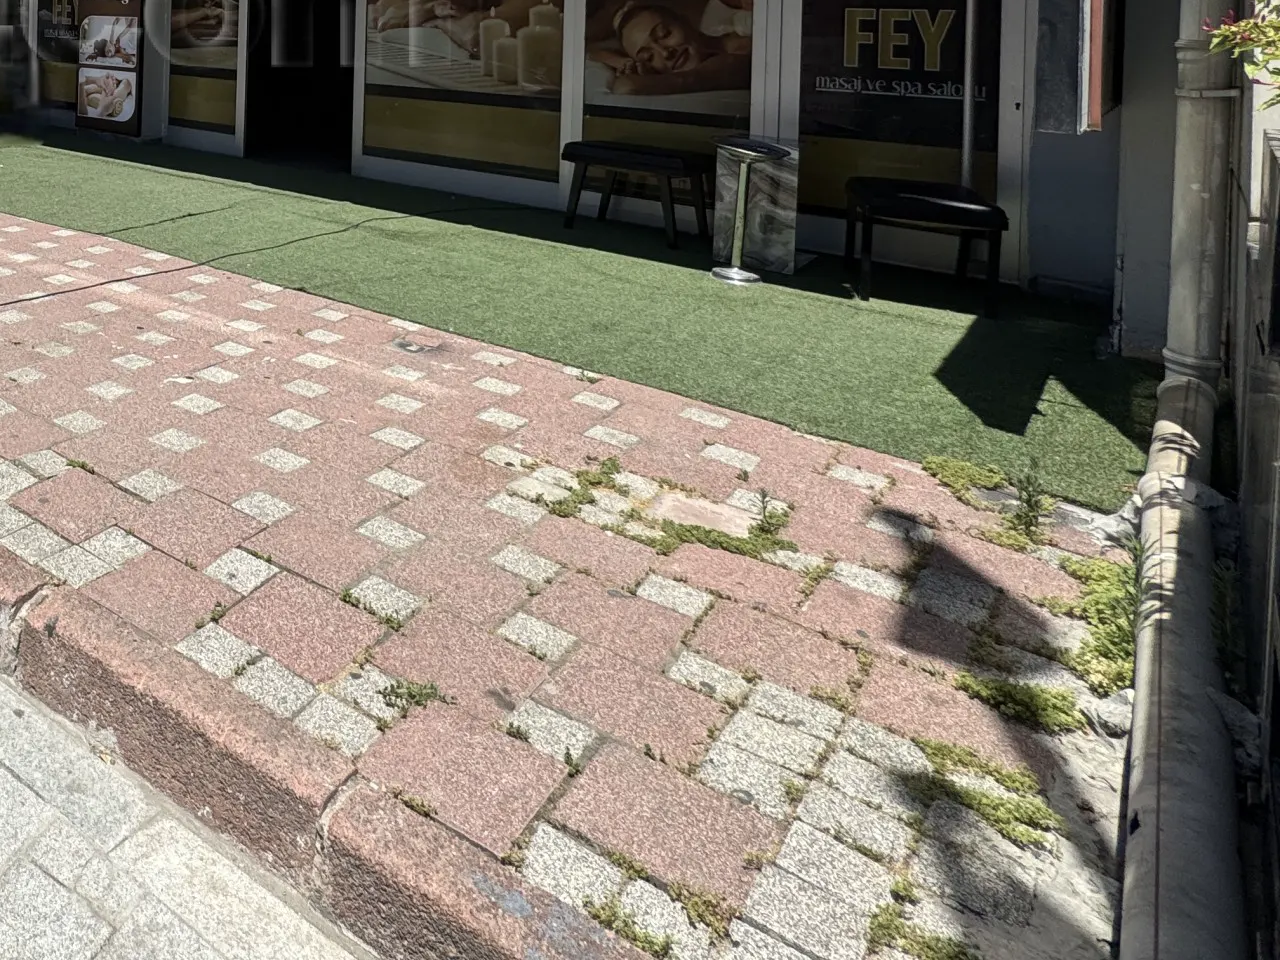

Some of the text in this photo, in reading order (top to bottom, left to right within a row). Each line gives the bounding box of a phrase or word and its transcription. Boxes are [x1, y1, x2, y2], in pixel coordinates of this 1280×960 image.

[842, 7, 956, 72] FEY
[815, 75, 986, 98] masaj ve spa salou
